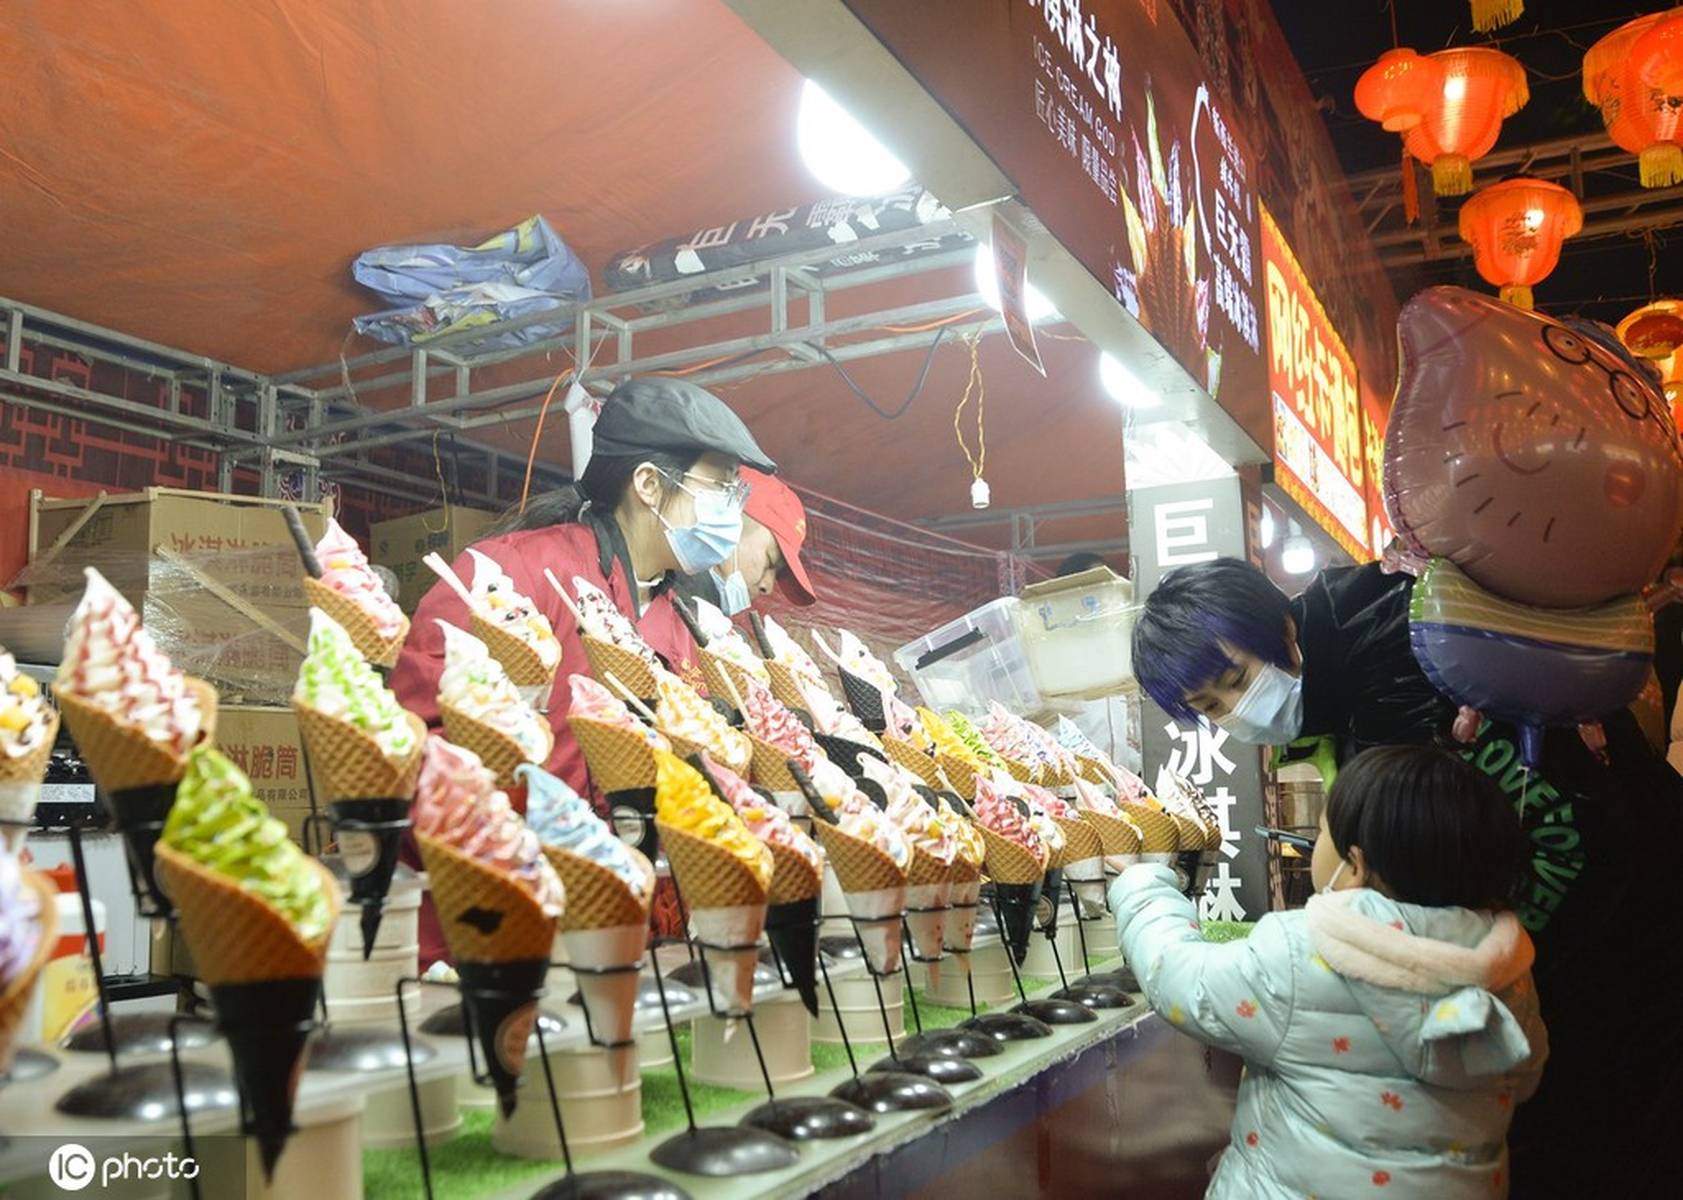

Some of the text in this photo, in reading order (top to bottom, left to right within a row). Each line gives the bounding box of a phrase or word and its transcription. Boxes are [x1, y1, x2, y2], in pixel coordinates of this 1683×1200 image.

[1028, 0, 1122, 122] 淇淋之神
[1033, 36, 1116, 157] ICE CREAM GOD
